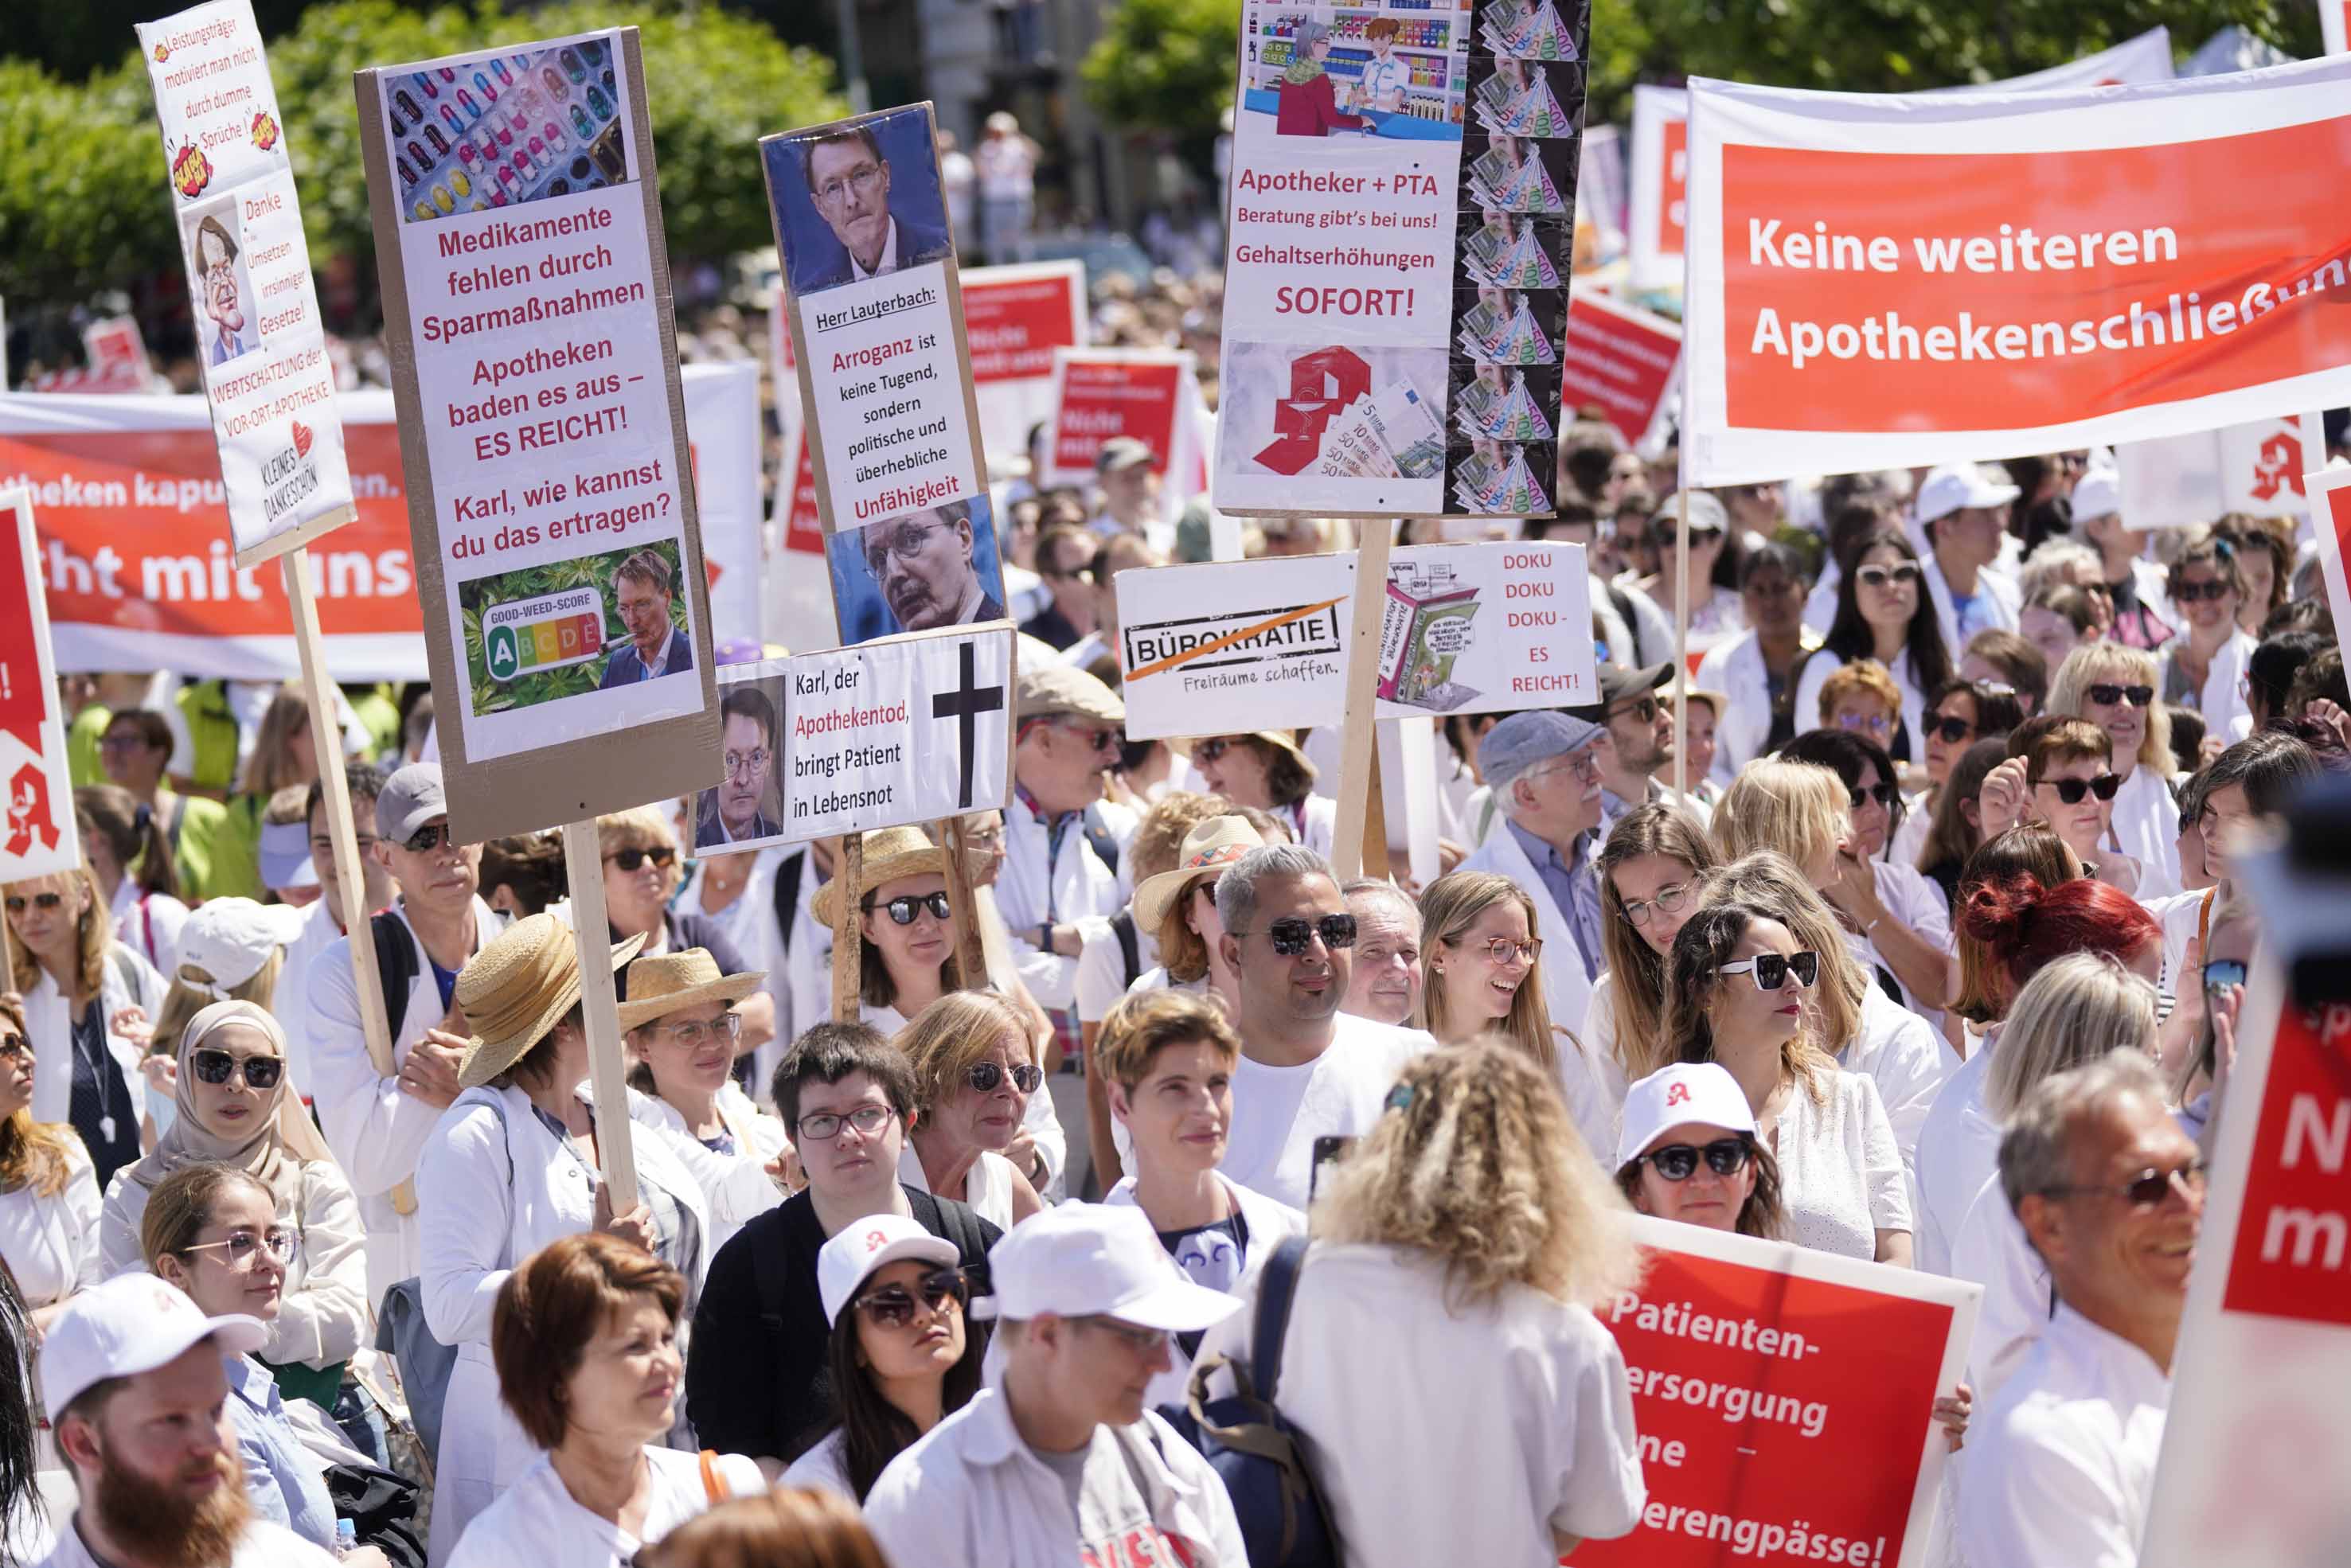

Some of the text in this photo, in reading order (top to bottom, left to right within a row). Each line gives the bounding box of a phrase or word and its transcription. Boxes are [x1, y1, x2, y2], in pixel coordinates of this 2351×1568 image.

[166, 18, 237, 53] Leistungsträger
[1555, 25, 1573, 54] 500
[165, 47, 257, 90] motiviert man nicht
[186, 84, 252, 119] durch dumme
[1548, 102, 1566, 131] 500
[202, 121, 241, 150] Sprüche
[1239, 169, 1366, 194] Apotheker
[1393, 175, 1438, 196] PTA
[1541, 177, 1558, 207] 500
[245, 191, 282, 220] Danke
[1238, 208, 1314, 228] Beratung
[1371, 212, 1396, 228] bei
[1402, 213, 1437, 228] uns!
[439, 206, 612, 257] Medikamente
[1750, 218, 2178, 274] Keine weiteren
[248, 242, 292, 269] Umsetzen
[448, 244, 612, 296] fehlen durch
[1236, 245, 1434, 271] Gehaltserhöhungen
[1537, 253, 1553, 282] 500
[261, 270, 306, 299] irrsinniger
[1275, 287, 1414, 317] SOFORT!
[260, 300, 305, 336] Gesetze!
[424, 282, 645, 344] Sparmaßnahmen
[817, 309, 847, 330] Herr
[852, 288, 936, 320] Lauterbach:
[1751, 255, 2351, 369] Apothekenschließun
[833, 333, 936, 372] Arroganz ist
[1533, 330, 1550, 357] 500
[214, 349, 322, 404] WERTSCHÄTZUNG der
[472, 339, 613, 386] Apotheken
[840, 364, 938, 401] keine Tugend,
[225, 381, 330, 438] VOR-ORT-APOTHEKE
[448, 393, 529, 427] baden
[537, 385, 568, 408] es
[576, 375, 621, 399] aus
[864, 398, 921, 423] sondern
[1363, 404, 1376, 416] 5
[475, 405, 627, 461] ES REICHT!
[1353, 423, 1367, 438] 10
[1529, 406, 1546, 434] 500
[849, 417, 947, 460] politische und
[1326, 446, 1343, 462] 50
[260, 447, 296, 488] KLEINES
[856, 447, 947, 483] überhebliche
[1321, 462, 1338, 477] 50
[135, 473, 225, 513] kapu
[263, 465, 318, 522] DANKESCHÖN
[454, 459, 662, 522] Karl, wie kannst
[854, 476, 959, 519] Unfähigkeit
[1528, 479, 1545, 507] 500
[451, 493, 670, 560] du das ertragen?
[1504, 553, 1552, 569] DOKU
[1505, 583, 1554, 598] DOKU
[491, 593, 591, 624] GOOD-WEED-SCORE
[1508, 611, 1556, 626] DOKU
[493, 643, 516, 666] A
[560, 626, 577, 649] D
[1138, 618, 1324, 662] BÜROKRATIE
[1529, 646, 1548, 662] ES
[796, 668, 859, 696] Karl, der
[1184, 661, 1338, 692] Freiräume schaffen.
[1513, 673, 1579, 692] REICHT!
[796, 700, 909, 739] Apothekentod,
[796, 743, 900, 778] bringt Patient
[795, 785, 892, 818] in Lebensnot
[1611, 1291, 1821, 1360] Patienten-
[1624, 1365, 1829, 1437] ersorgung
[1643, 1500, 1887, 1567] erengpässe!
